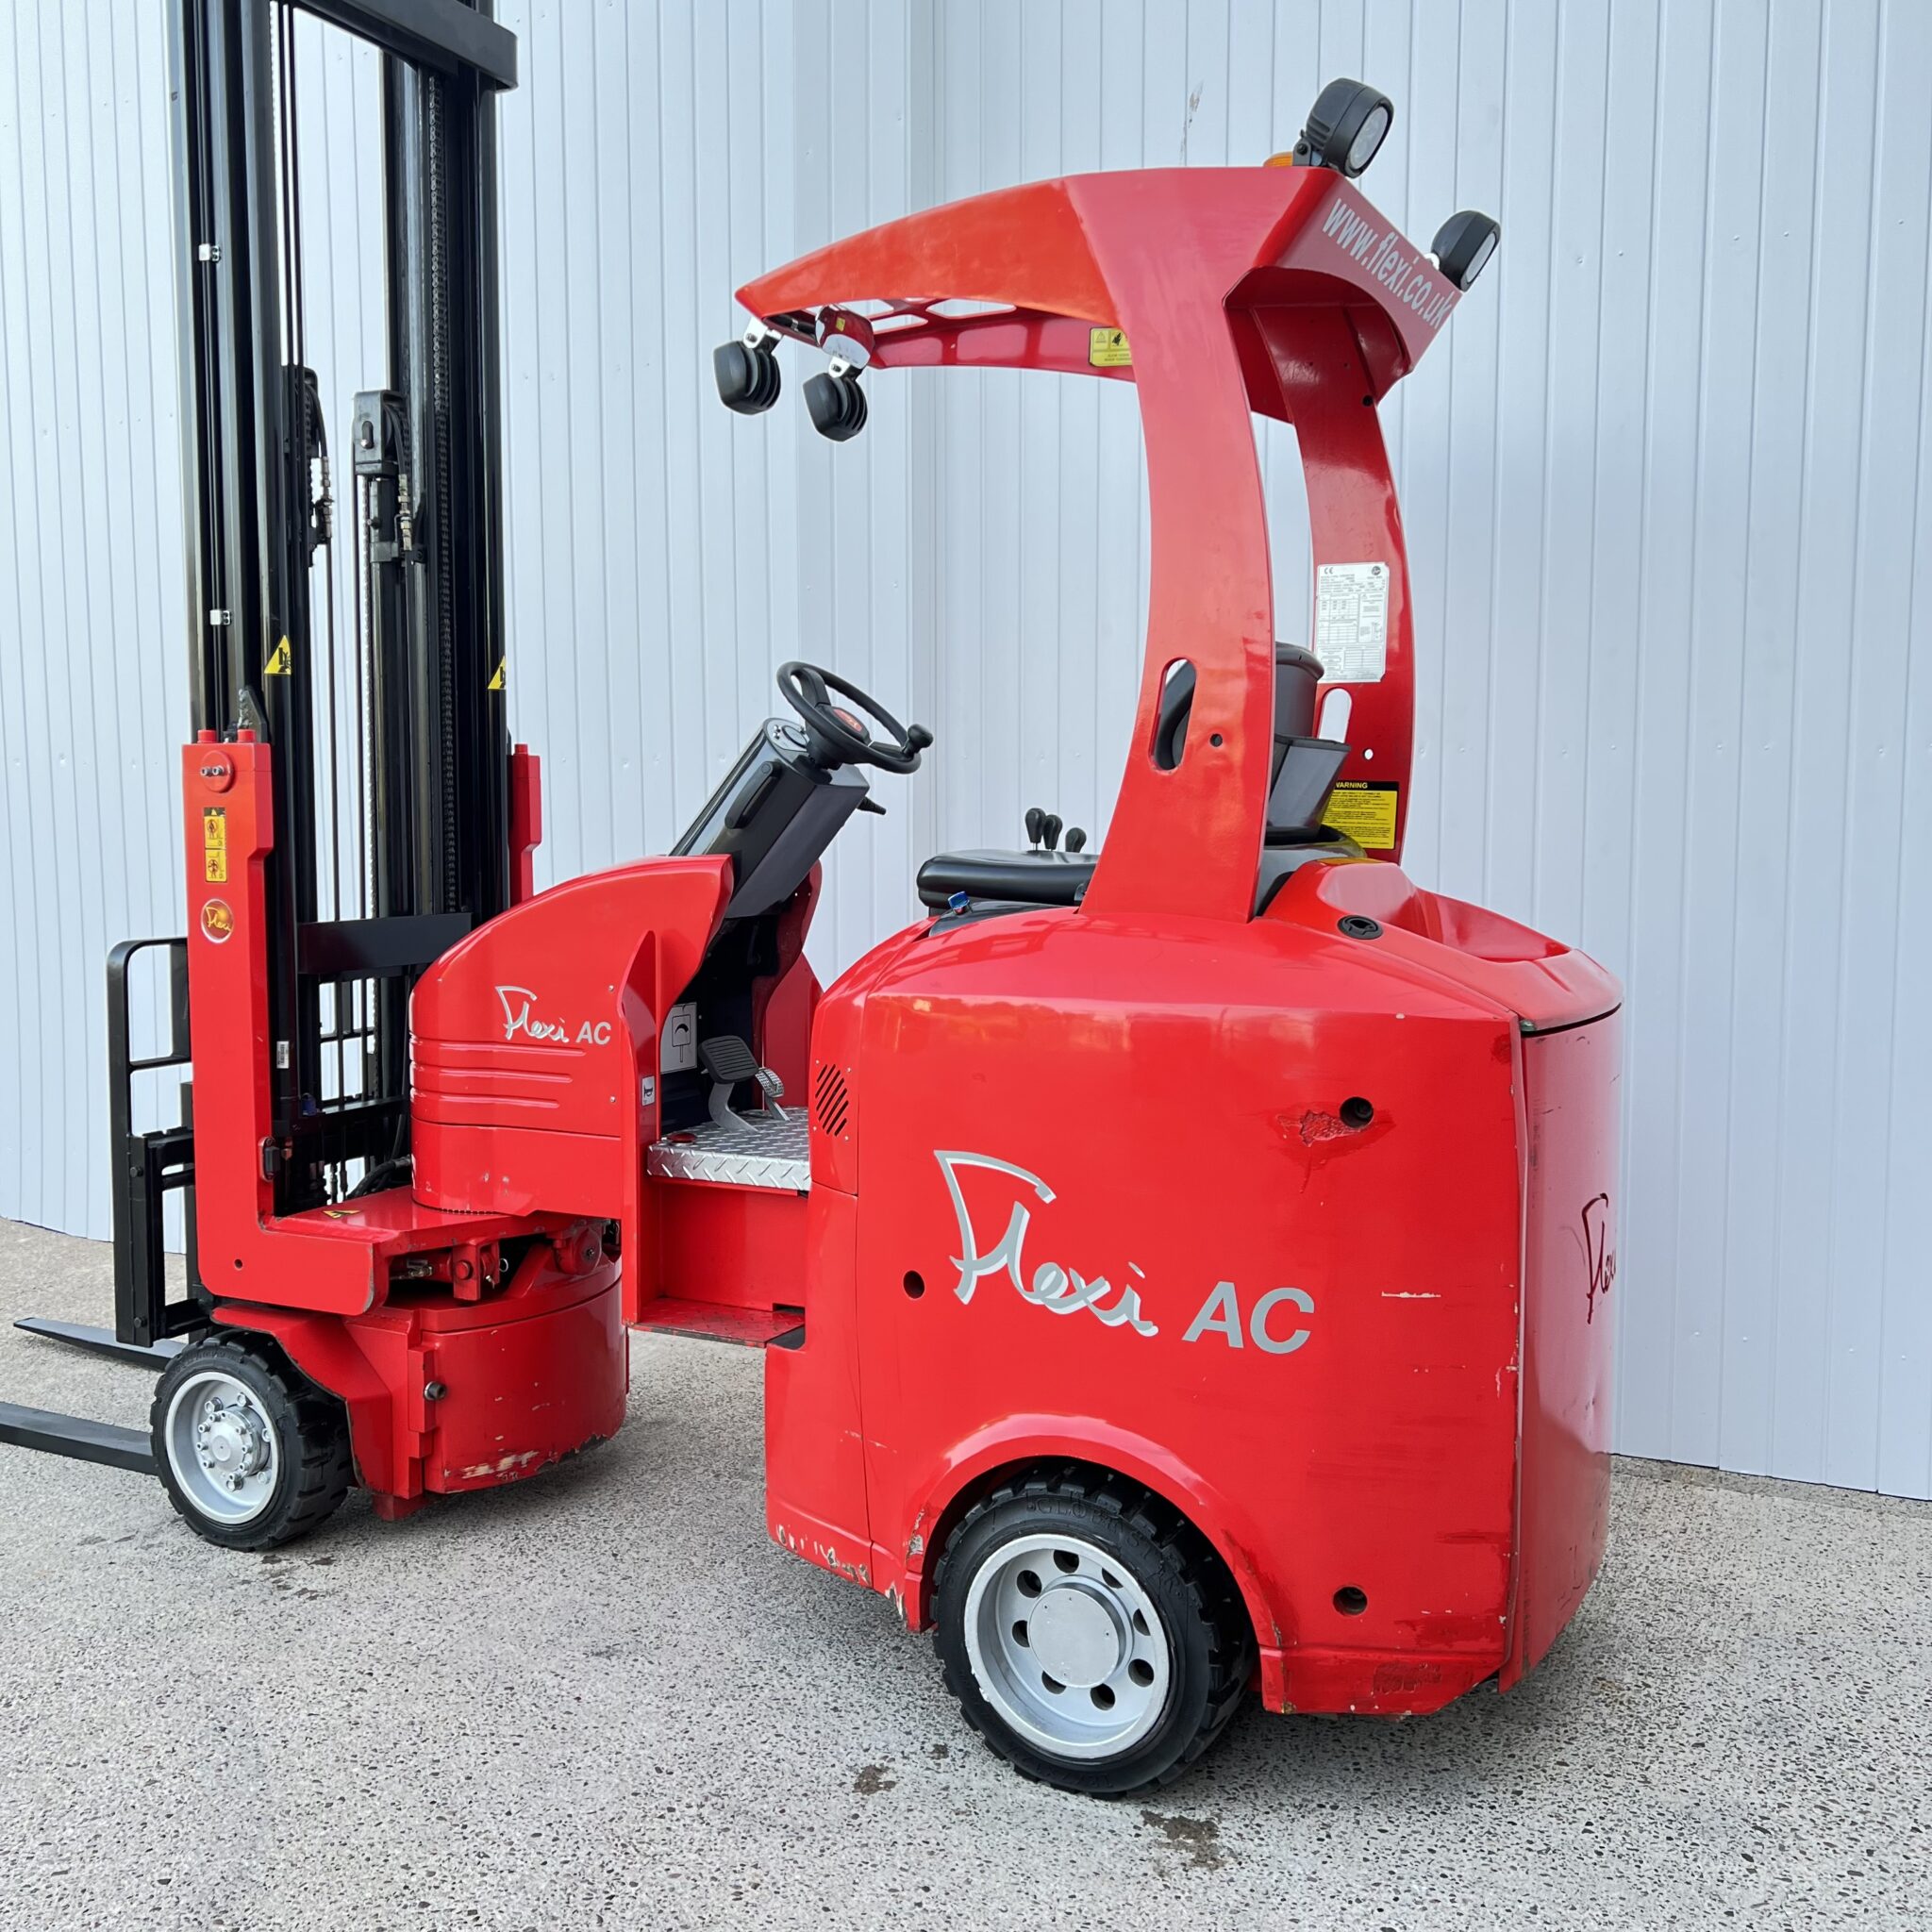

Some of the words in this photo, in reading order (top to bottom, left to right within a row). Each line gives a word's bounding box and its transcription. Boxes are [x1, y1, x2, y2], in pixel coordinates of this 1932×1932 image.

[1323, 198, 1455, 329] www.flexi.co.uk
[495, 985, 570, 1043] Flexi
[575, 1021, 612, 1045] AC
[933, 1149, 1159, 1338] Flexi
[1181, 1280, 1315, 1355] AC
[1581, 1191, 1617, 1324] Flex
